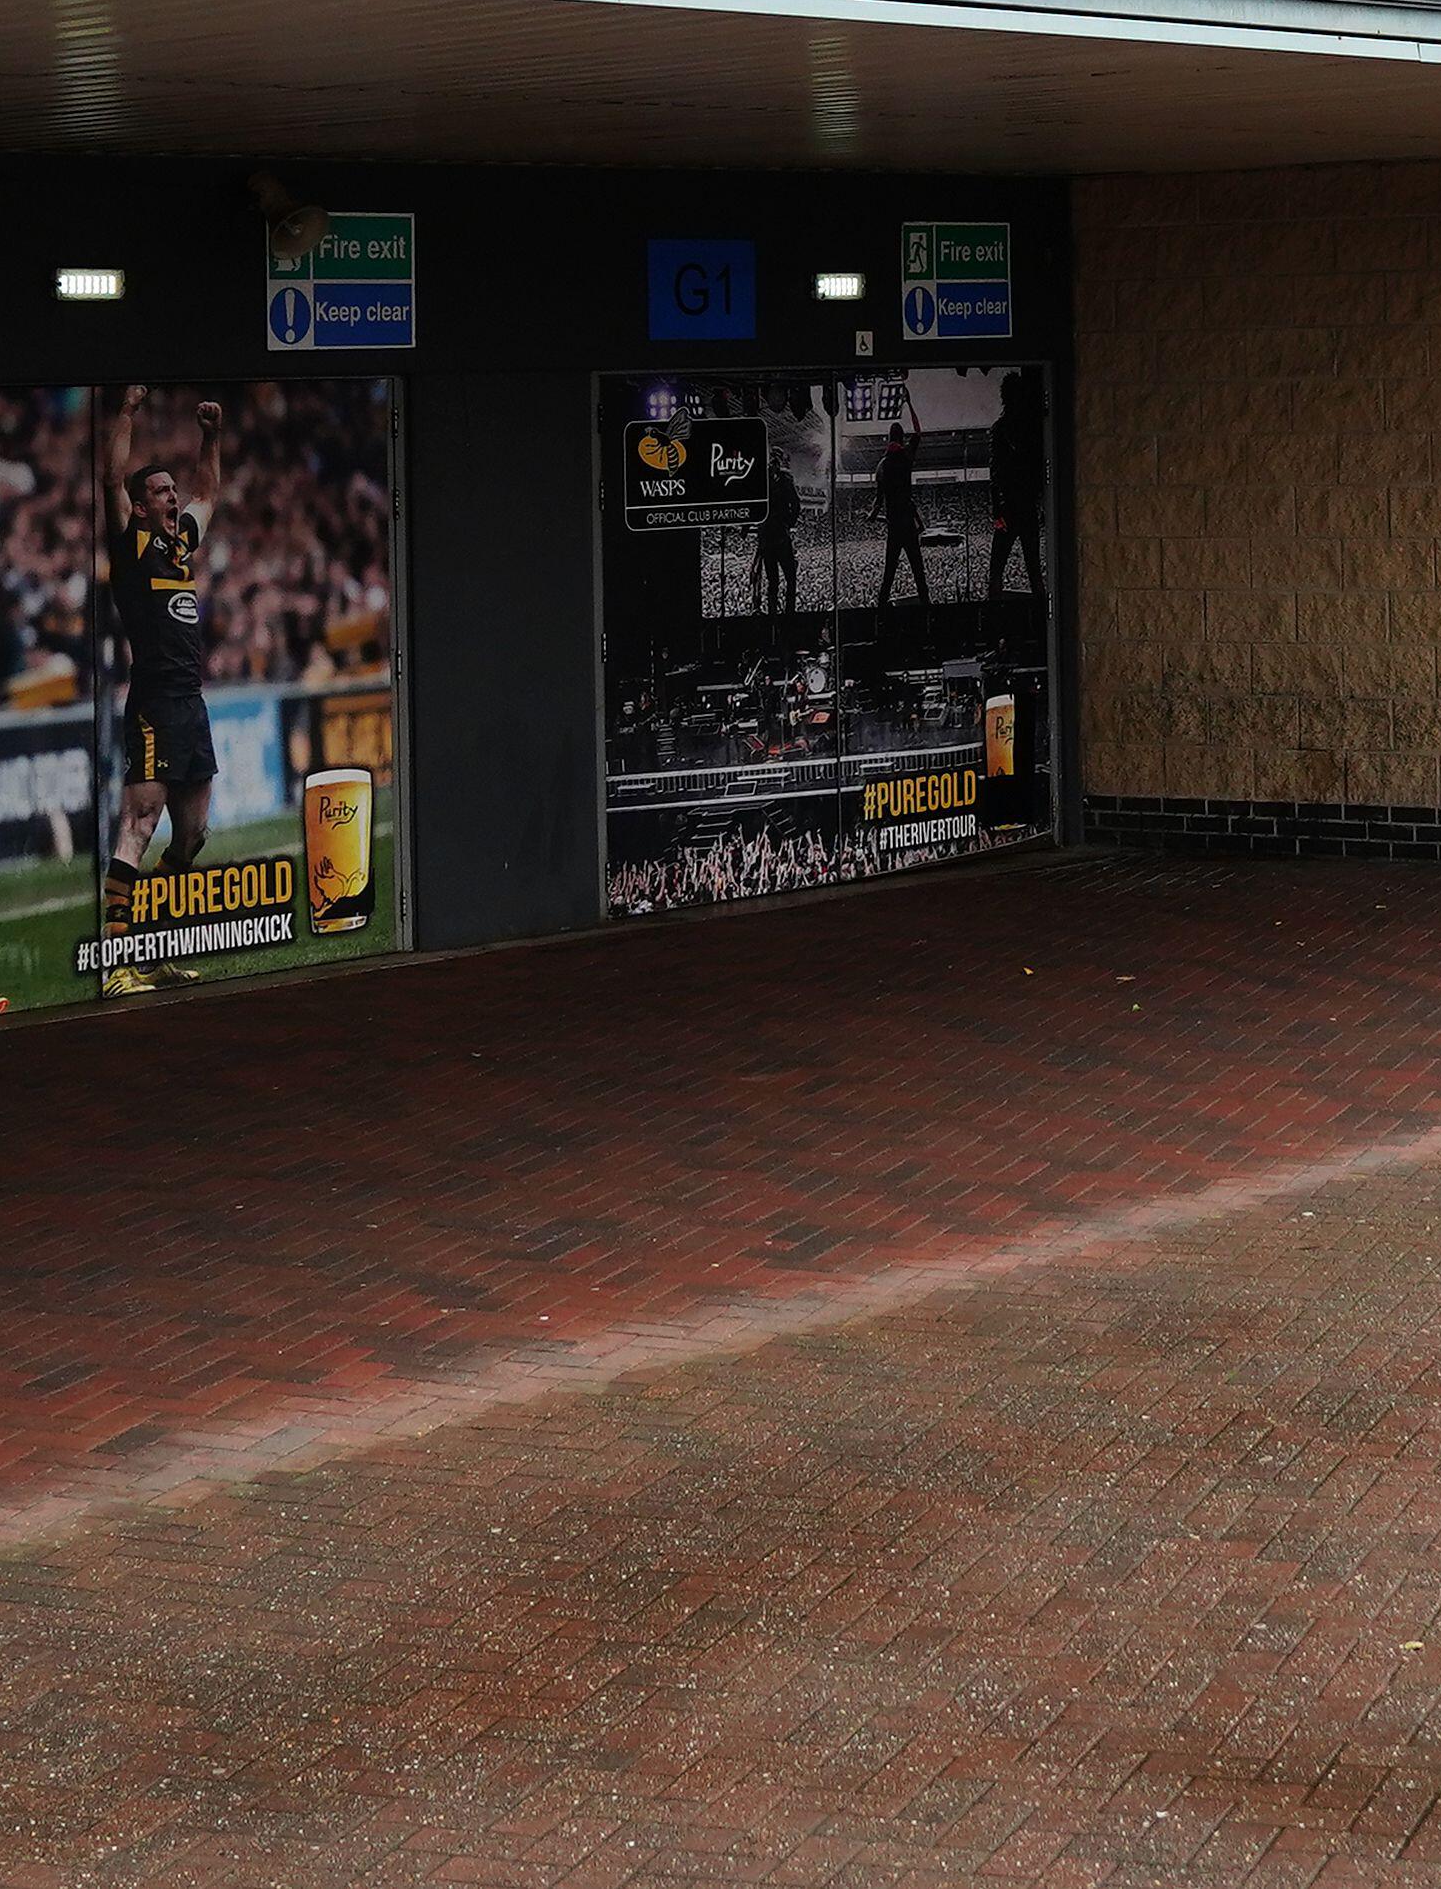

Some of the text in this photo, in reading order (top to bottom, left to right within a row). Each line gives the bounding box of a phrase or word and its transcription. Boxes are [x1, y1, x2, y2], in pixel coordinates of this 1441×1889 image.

[319, 235, 406, 259] Fire exit
[940, 241, 1004, 263] Fire exit
[673, 262, 733, 318] G1
[316, 301, 409, 327] Keep clear
[938, 298, 1007, 320] Keep clear
[711, 443, 755, 486] Purity
[640, 479, 686, 497] WASPS
[646, 507, 750, 524] OFFICIAL CLUB PARTNER
[864, 769, 977, 821] #PUREGOLD
[319, 796, 358, 830] Purity
[880, 814, 977, 851] #THERIVERTOUR
[131, 860, 293, 924] #PUREGOLD
